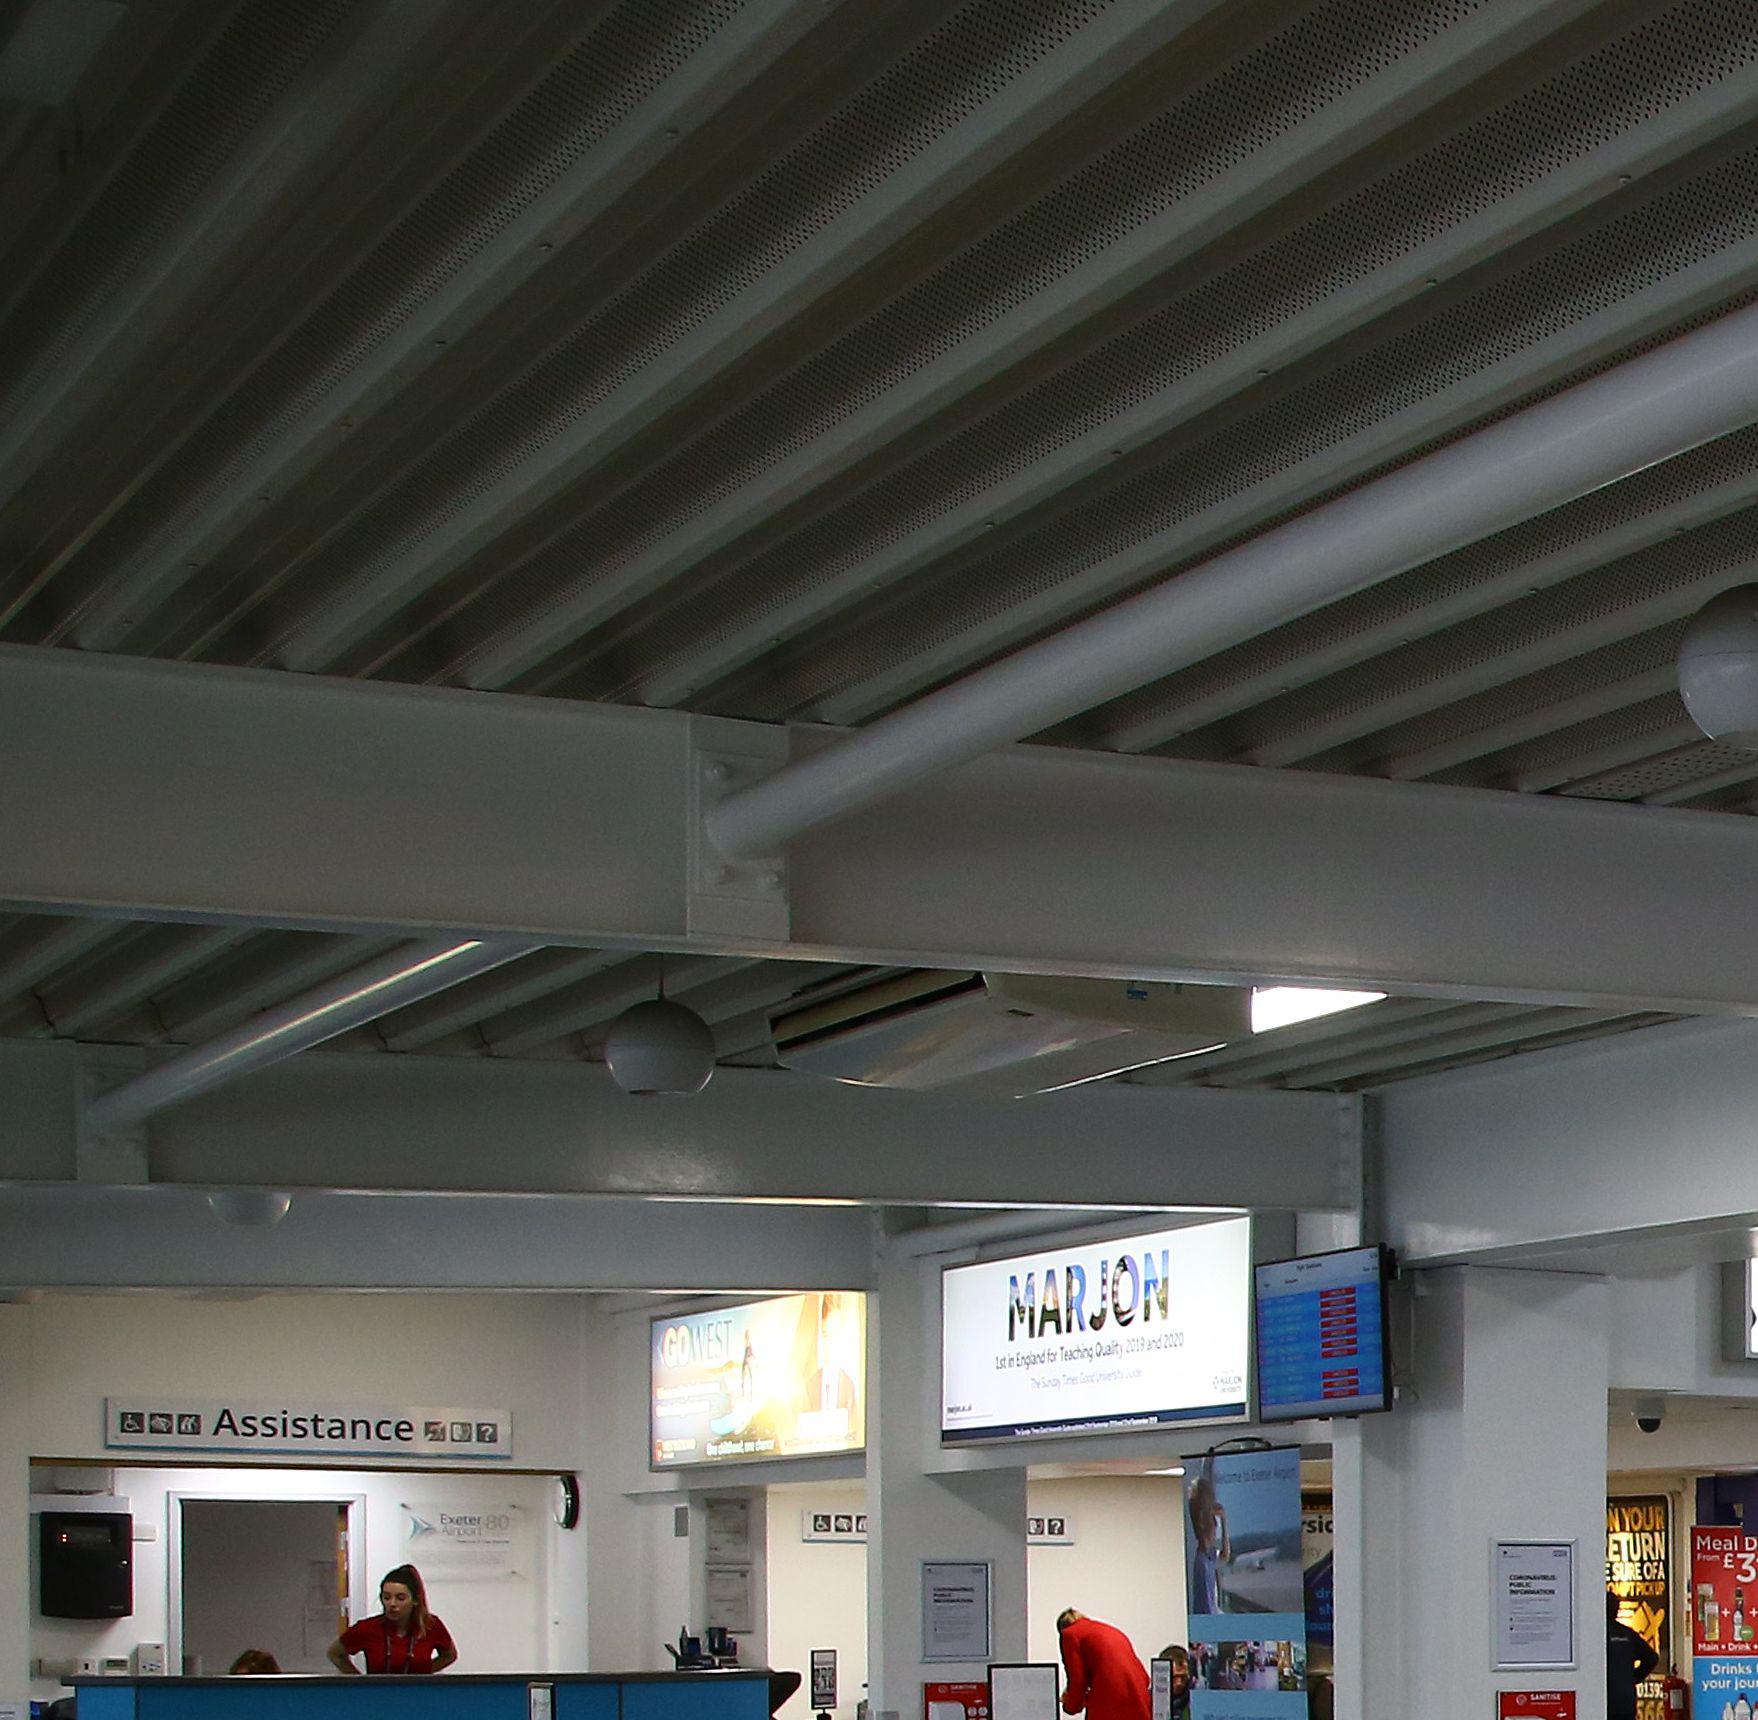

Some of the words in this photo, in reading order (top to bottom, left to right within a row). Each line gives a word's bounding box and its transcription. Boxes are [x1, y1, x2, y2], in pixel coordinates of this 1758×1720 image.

[1008, 1249, 1170, 1342] MARJON
[995, 1354, 1007, 1370] 1st
[1016, 1347, 1046, 1371] England
[1047, 1346, 1058, 1364] for
[1060, 1341, 1093, 1363] Teaching
[1095, 1341, 1124, 1359] Quality
[1146, 1333, 1162, 1351] and
[1163, 1331, 1184, 1349] 2020
[212, 1407, 415, 1442] Assistance
[440, 1513, 482, 1526] Exeter
[1620, 1506, 1665, 1532] YOUR
[1607, 1532, 1666, 1561] ETURN
[1696, 1536, 1739, 1552] Meal
[1697, 1553, 1720, 1562] From
[1612, 1562, 1643, 1581] SURE
[1643, 1562, 1656, 1580] OF
[1657, 1562, 1666, 1580] A
[1698, 1643, 1720, 1651] Main
[1728, 1642, 1751, 1651] Drink
[1711, 1662, 1752, 1675] Drinks
[1702, 1677, 1731, 1691] your
